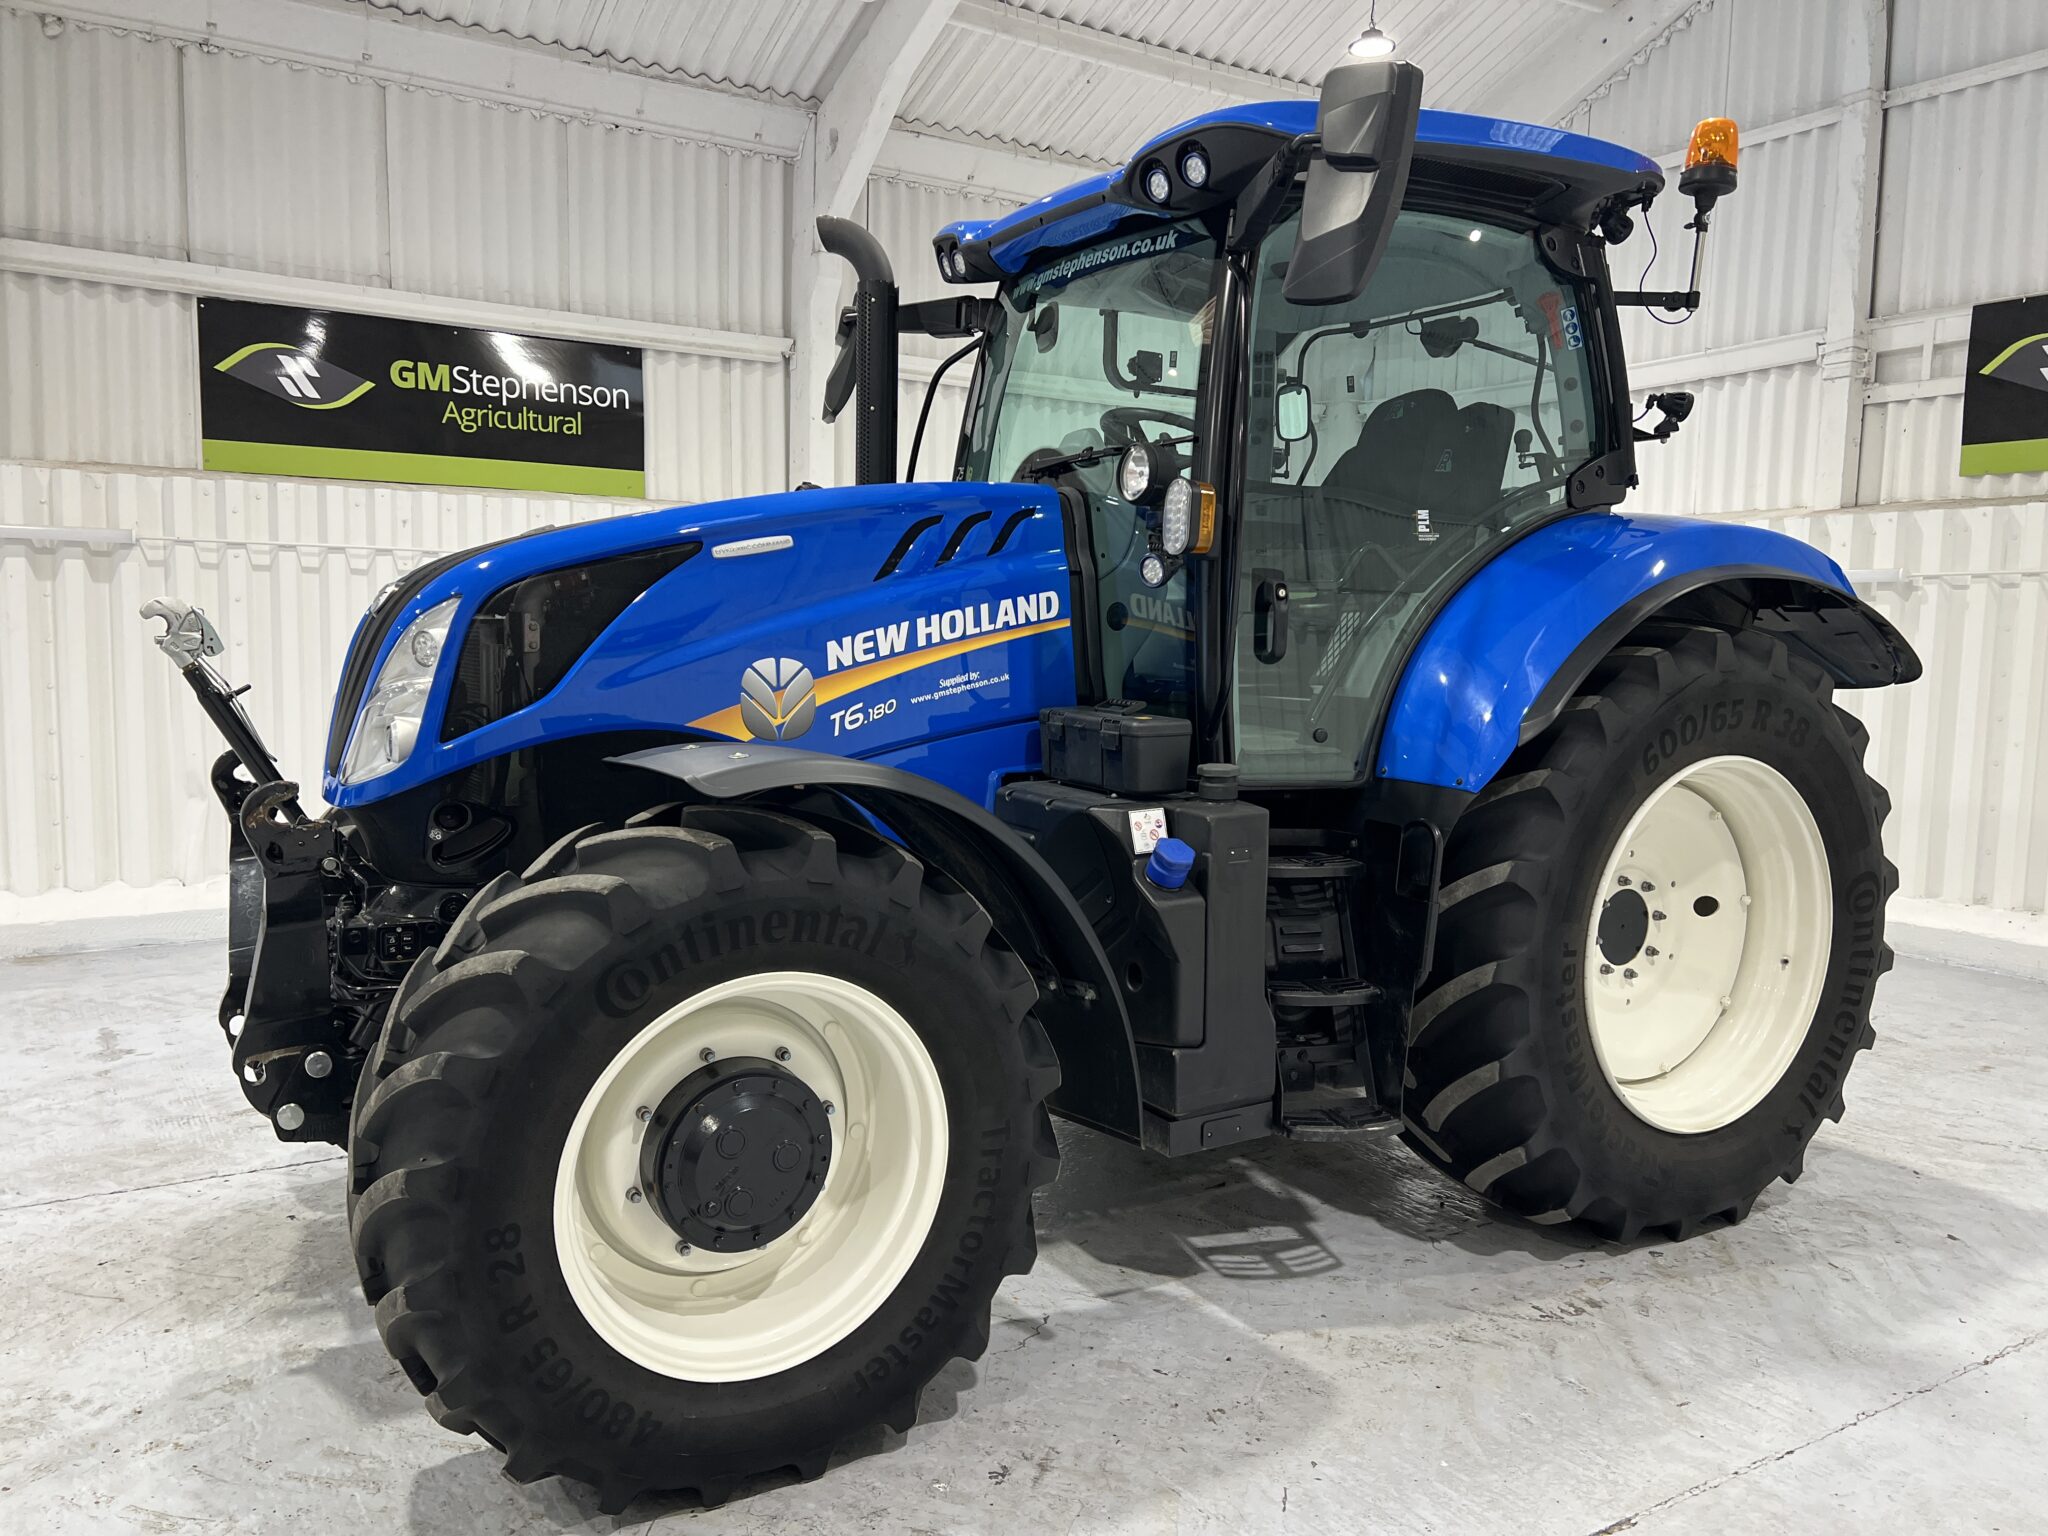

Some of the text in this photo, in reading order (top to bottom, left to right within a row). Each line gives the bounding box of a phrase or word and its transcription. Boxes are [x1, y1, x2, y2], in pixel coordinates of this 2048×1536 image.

[1012, 229, 1179, 299] www.gmstephenson.co.uk
[442, 401, 582, 436] Agricultural
[1418, 509, 1430, 532] PLM
[825, 590, 1060, 672] NEW HOLLAND
[910, 673, 1010, 704] www.gmstephenson.co.uk
[939, 672, 969, 688] Supplied
[830, 698, 897, 737] T6.180
[1642, 698, 1811, 776] 600/65 R 38
[594, 904, 892, 1019] Continental
[1796, 871, 1881, 1119] Continental
[854, 1119, 1011, 1399] TractorMaster
[484, 1222, 663, 1448] 480/65 R 28
